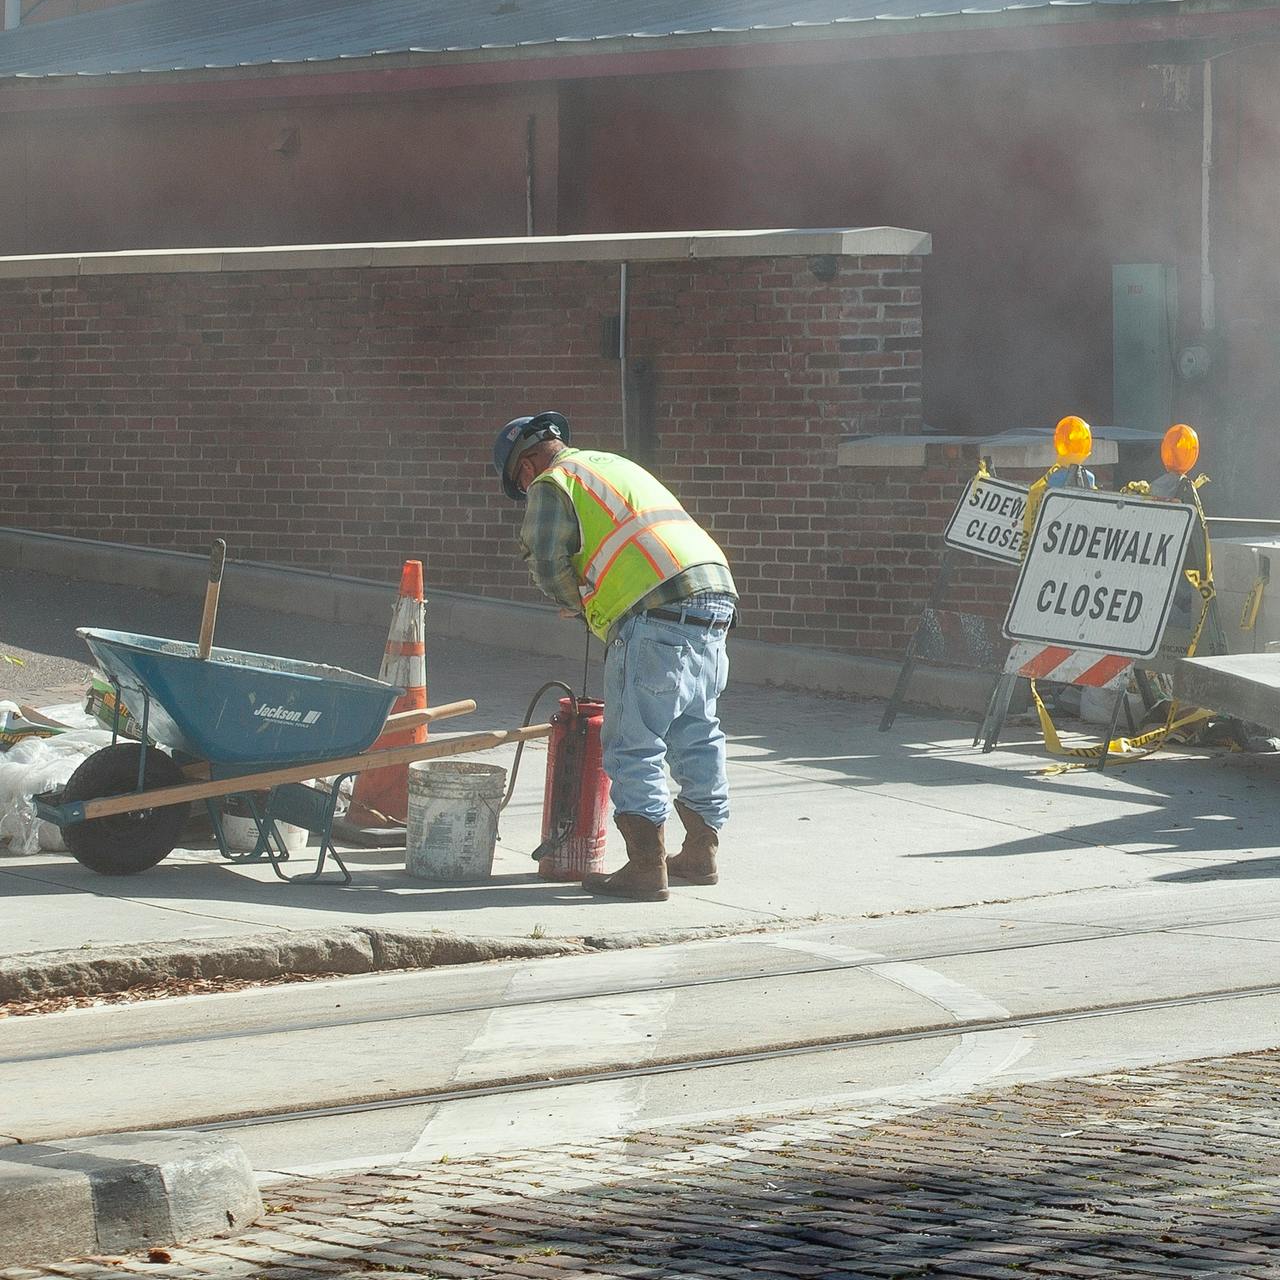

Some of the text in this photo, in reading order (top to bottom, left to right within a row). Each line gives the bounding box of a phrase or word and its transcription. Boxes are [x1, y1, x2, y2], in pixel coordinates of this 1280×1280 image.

[968, 487, 1027, 521] SIDEW
[1042, 520, 1174, 567] SIDEWALK
[1036, 580, 1144, 624] CLOSED
[253, 703, 302, 721] Jackson
